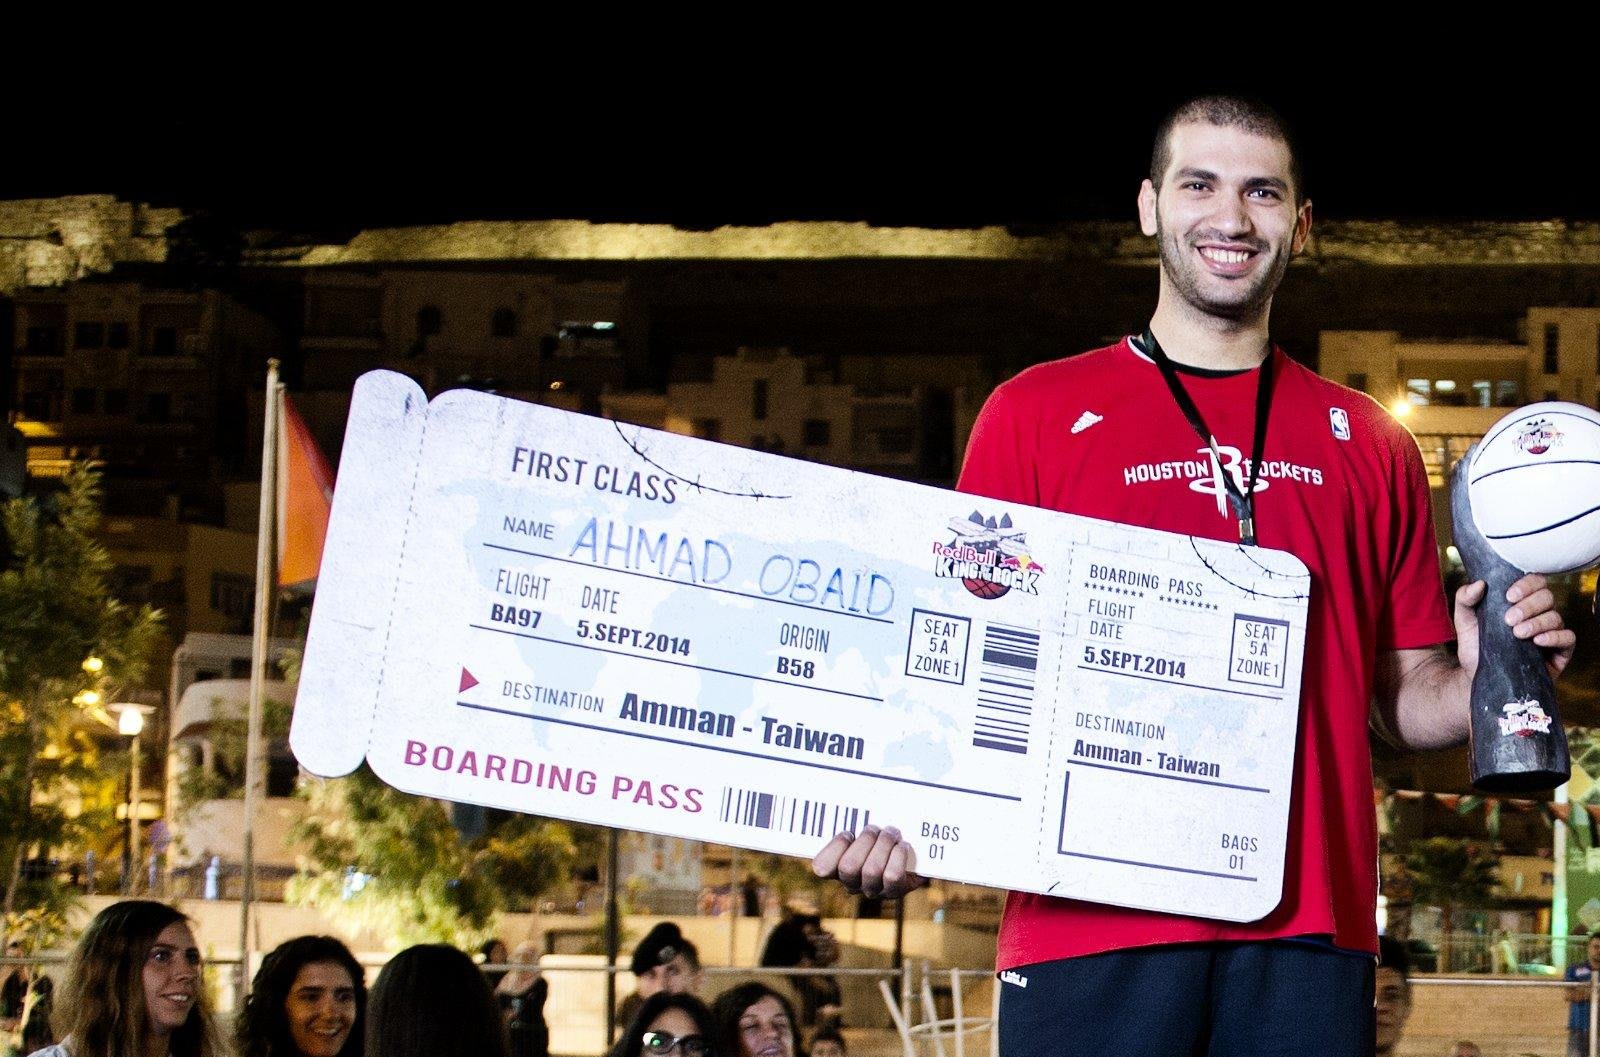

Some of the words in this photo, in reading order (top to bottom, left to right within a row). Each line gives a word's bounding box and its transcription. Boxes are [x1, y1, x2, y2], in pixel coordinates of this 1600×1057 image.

[512, 447, 587, 485] FIRST
[594, 464, 678, 504] CLASS
[1124, 459, 1208, 486] HOUSTON
[503, 516, 554, 540] NAME
[570, 517, 732, 584] AHMAD
[759, 554, 895, 616] OBAID
[496, 569, 550, 600] FLIGHT
[581, 586, 620, 614] DATE
[1089, 564, 1159, 590] BOARDING
[1169, 579, 1202, 597] PASS
[1089, 599, 1135, 621] FLIGHT
[491, 604, 541, 628] BA97
[576, 619, 691, 657] 5.SEPT.2014
[780, 623, 830, 653] ORIGIN
[924, 618, 959, 638] SEAT
[1090, 619, 1123, 639] DATE
[1244, 622, 1277, 641] SEAT
[777, 656, 814, 679] B58
[1083, 645, 1187, 679] 5.SEPT.2014
[503, 679, 605, 713] DESTINATION
[619, 691, 735, 739] Amman
[761, 715, 866, 760] Taiwan
[1076, 713, 1165, 740] DESTINATION
[1073, 739, 1142, 766] Amman
[1158, 752, 1221, 778] Taiwan
[403, 738, 597, 797] BOARDING
[612, 776, 703, 812] PASS
[922, 822, 959, 841] BAGS
[1222, 834, 1257, 852] BAGS
[929, 844, 944, 860] 01
[1230, 855, 1243, 870] 01
